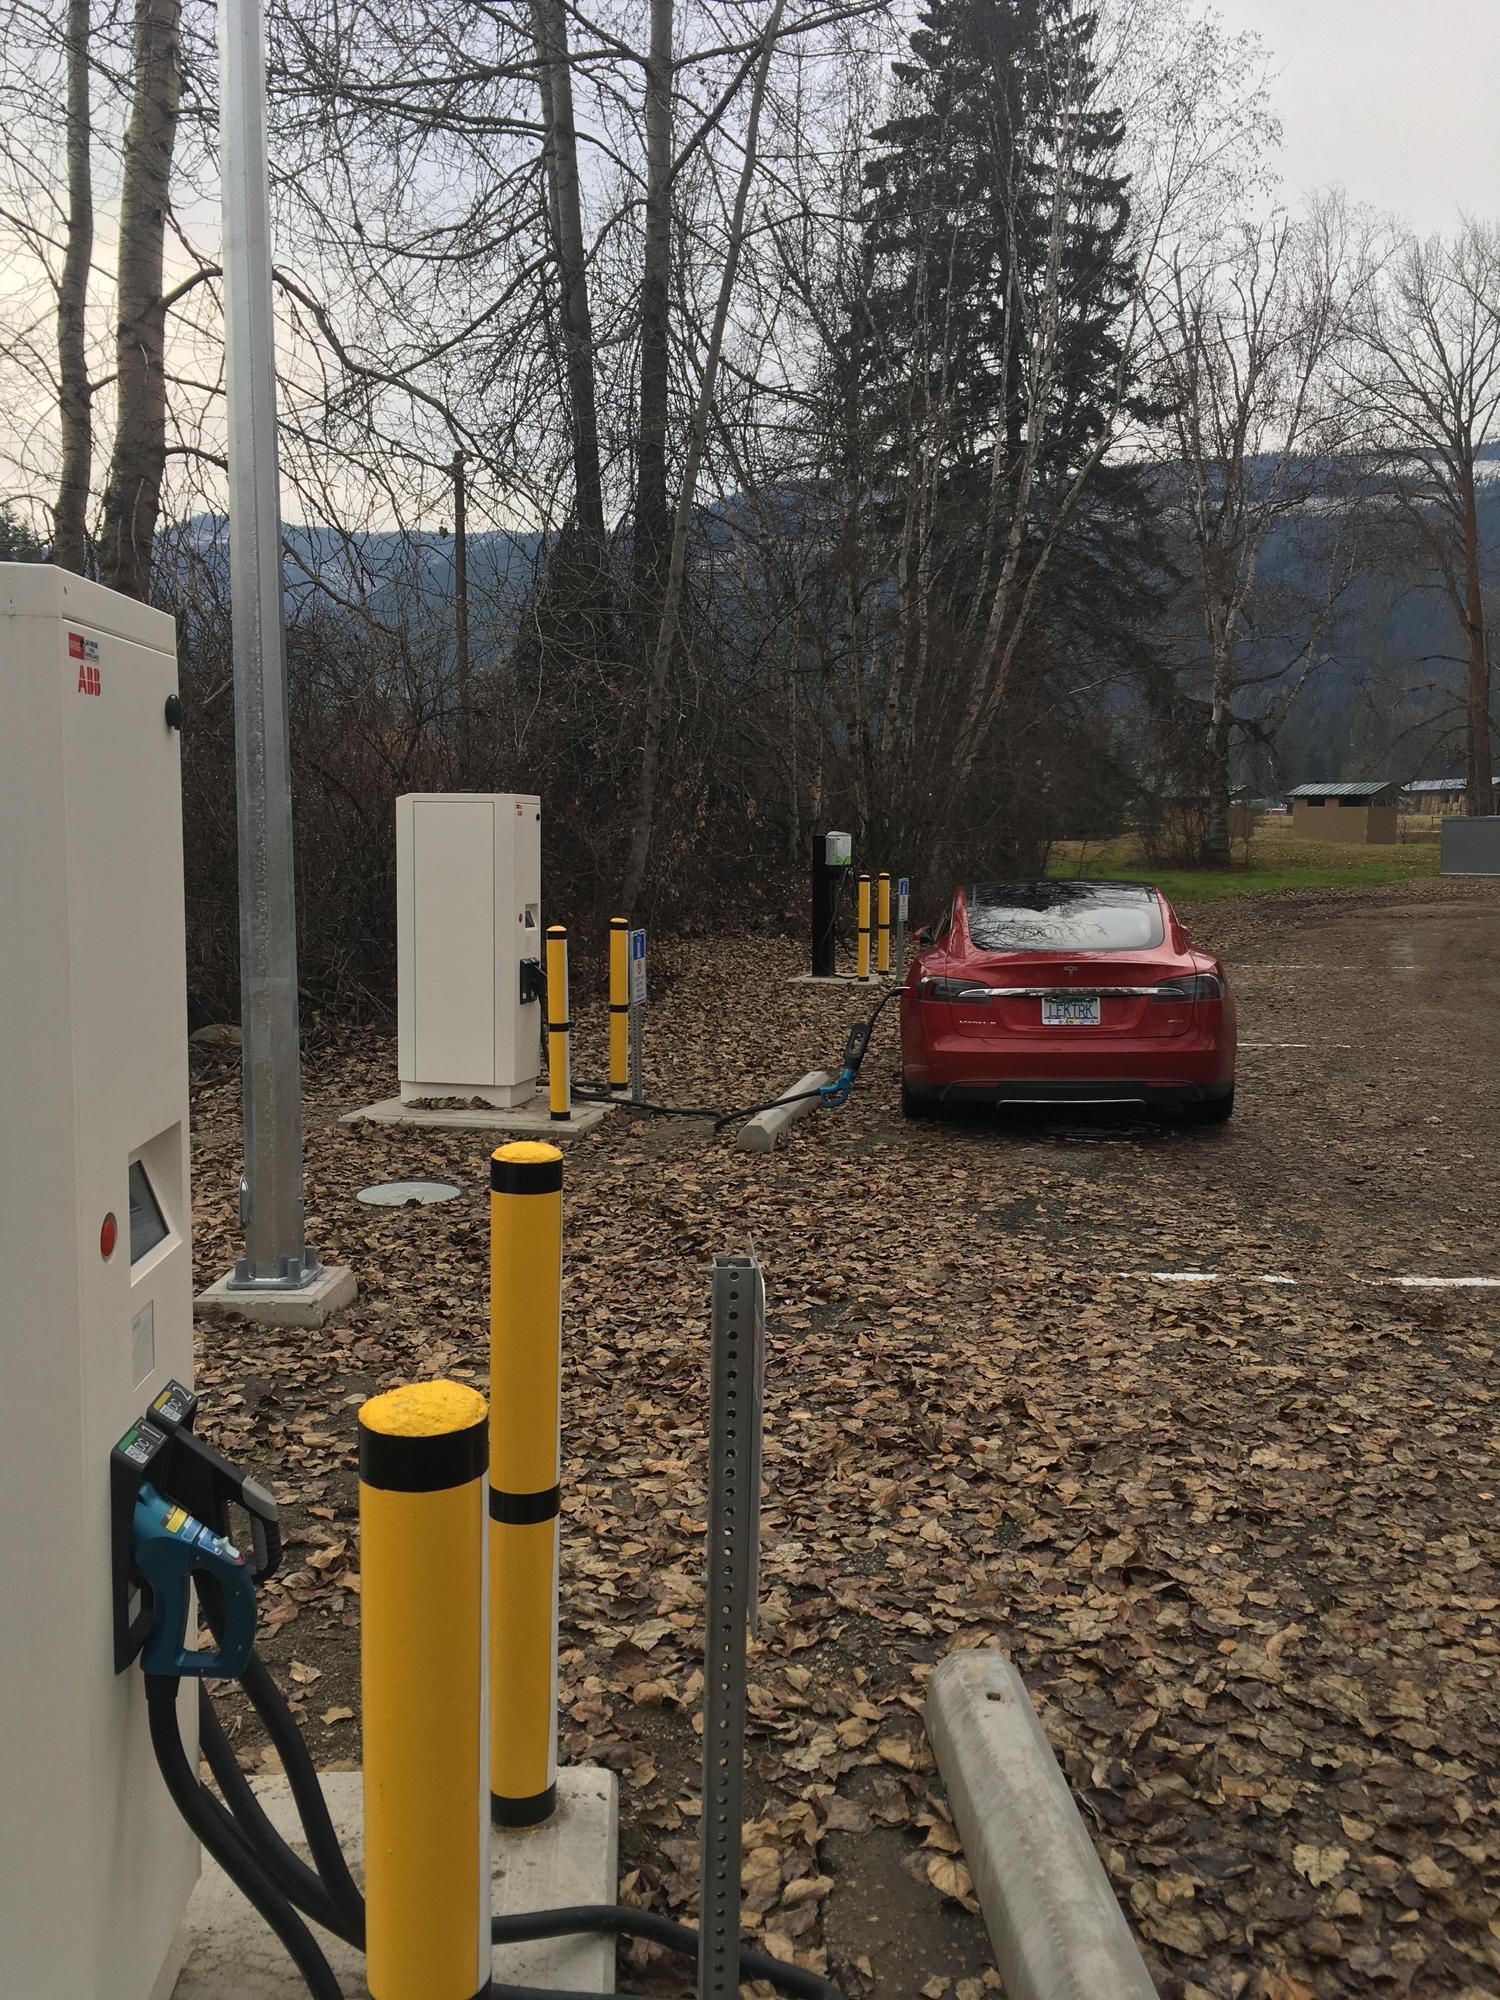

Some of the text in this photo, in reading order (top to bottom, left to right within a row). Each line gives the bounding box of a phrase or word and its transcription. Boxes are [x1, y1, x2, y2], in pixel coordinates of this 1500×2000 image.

[78, 665, 101, 697] ABB
[1049, 1003, 1093, 1018] LEKTRK
[172, 1386, 192, 1401] 2
[168, 1398, 182, 1411] DC
[141, 1425, 161, 1439] 1
[134, 1438, 150, 1452] DC
